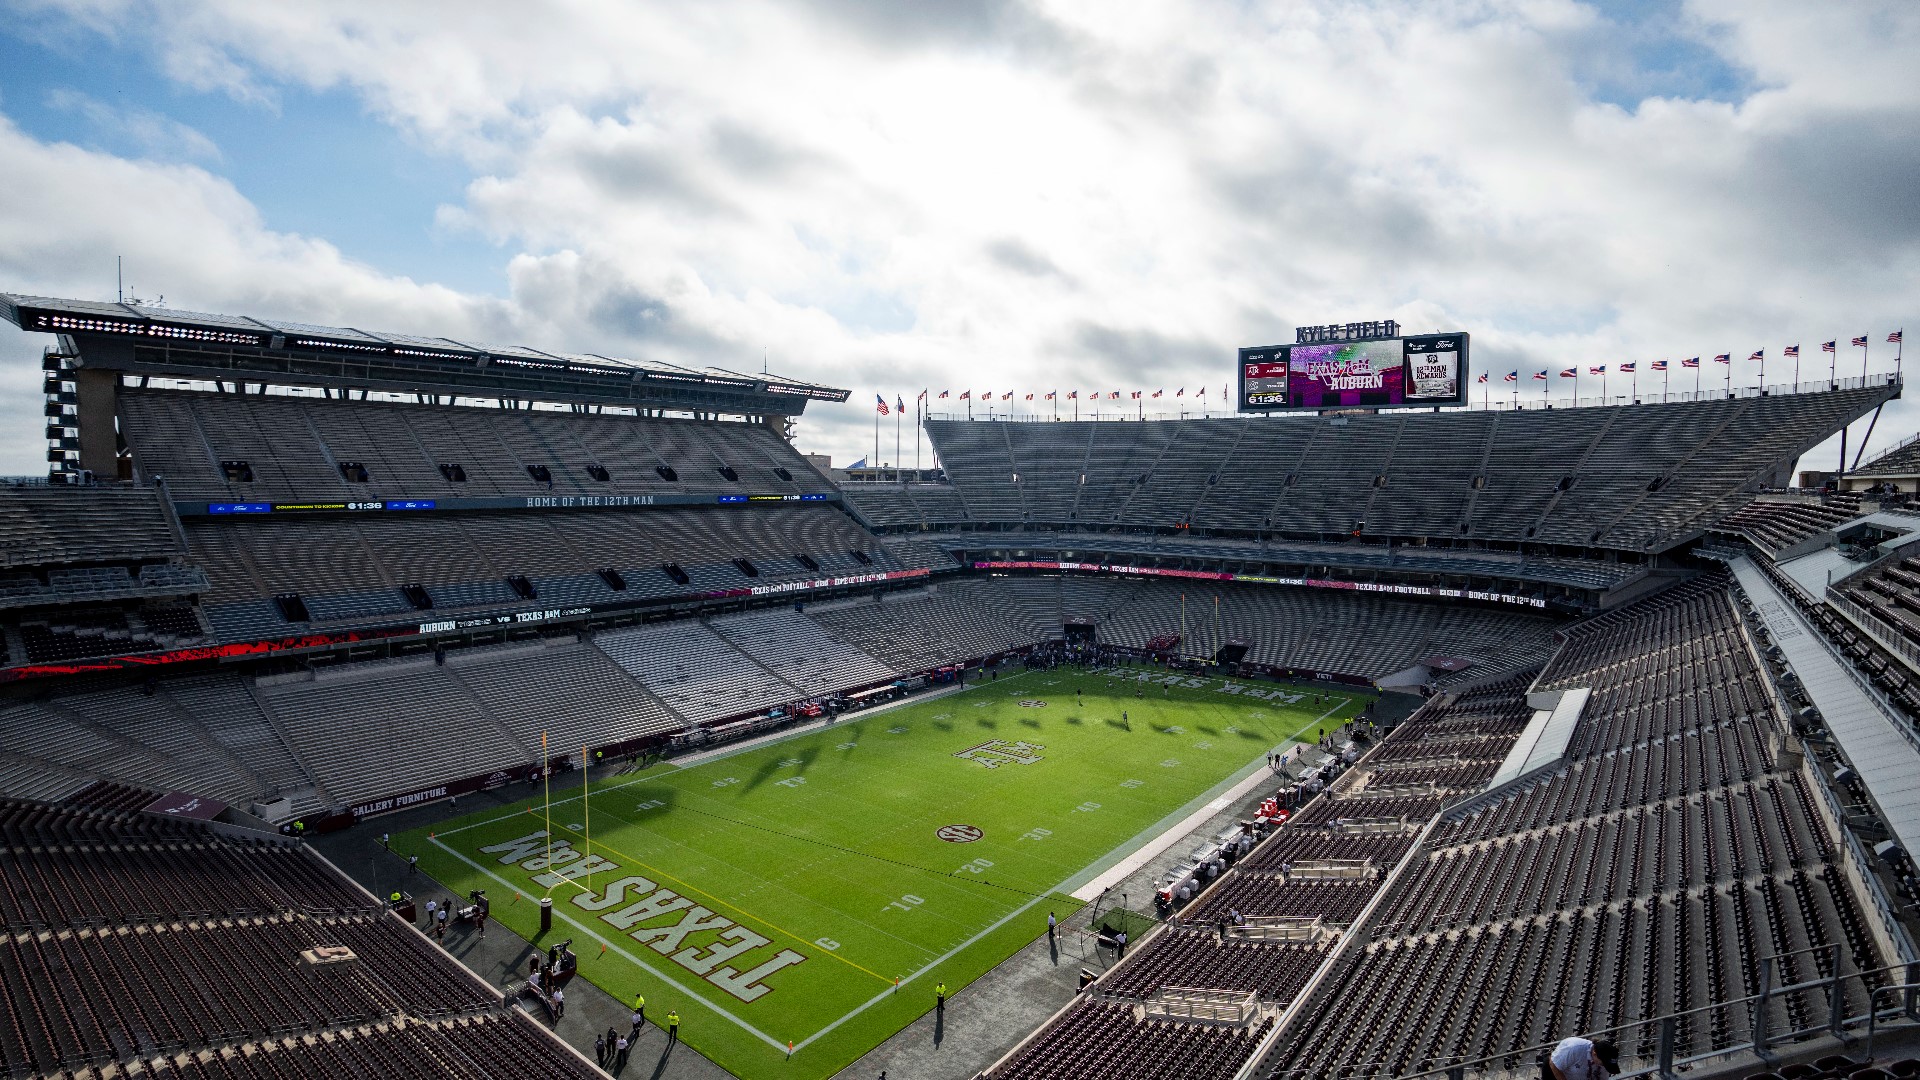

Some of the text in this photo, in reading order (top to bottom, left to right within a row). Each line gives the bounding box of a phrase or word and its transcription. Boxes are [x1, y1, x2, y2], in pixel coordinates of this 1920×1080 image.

[1296, 320, 1395, 343] KYLE FIELD
[1416, 372, 1447, 380] REWARDS
[1430, 365, 1447, 373] MAN
[1331, 375, 1383, 390] AUBURN
[1248, 395, 1284, 403] 61:36
[348, 502, 382, 510] 61:36
[527, 496, 654, 507] HOME OF THE 12TH MAN
[1355, 582, 1377, 591] TEXAS
[1379, 585, 1392, 593] A&M
[1394, 586, 1431, 595] FOOTBALL
[1468, 591, 1488, 601] HOME
[1490, 594, 1500, 602] OF
[1502, 595, 1515, 604] THE
[1530, 598, 1545, 608] MAN
[419, 621, 456, 634] AUBURN
[516, 611, 543, 623] TEXAS
[544, 609, 561, 620] A&M
[1315, 672, 1333, 681] YETI
[1214, 684, 1305, 704] A&M
[352, 787, 447, 817] GALLERY FURNITURE
[1077, 801, 1102, 812] 40
[1023, 827, 1053, 841] 30
[477, 829, 622, 889] A&M
[961, 858, 994, 874] 20
[890, 894, 925, 911] 10
[570, 875, 809, 1004] TEXAS
[815, 937, 841, 951] G
